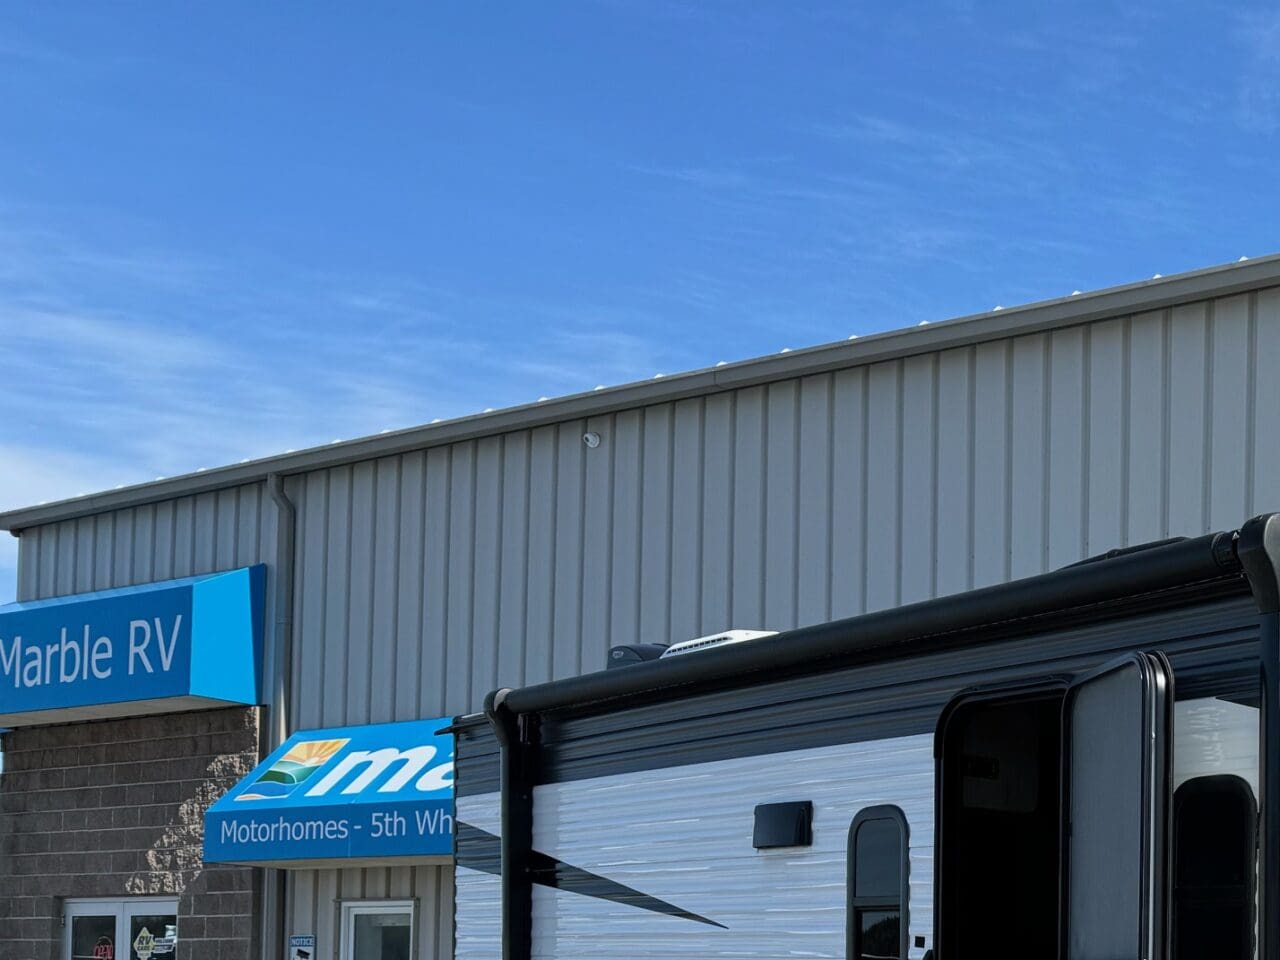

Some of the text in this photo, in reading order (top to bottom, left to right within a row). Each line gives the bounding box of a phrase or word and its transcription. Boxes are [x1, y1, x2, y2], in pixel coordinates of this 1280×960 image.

[0, 614, 182, 688] Marble RV
[221, 816, 349, 844] Motorhomes
[370, 810, 407, 838] 5th
